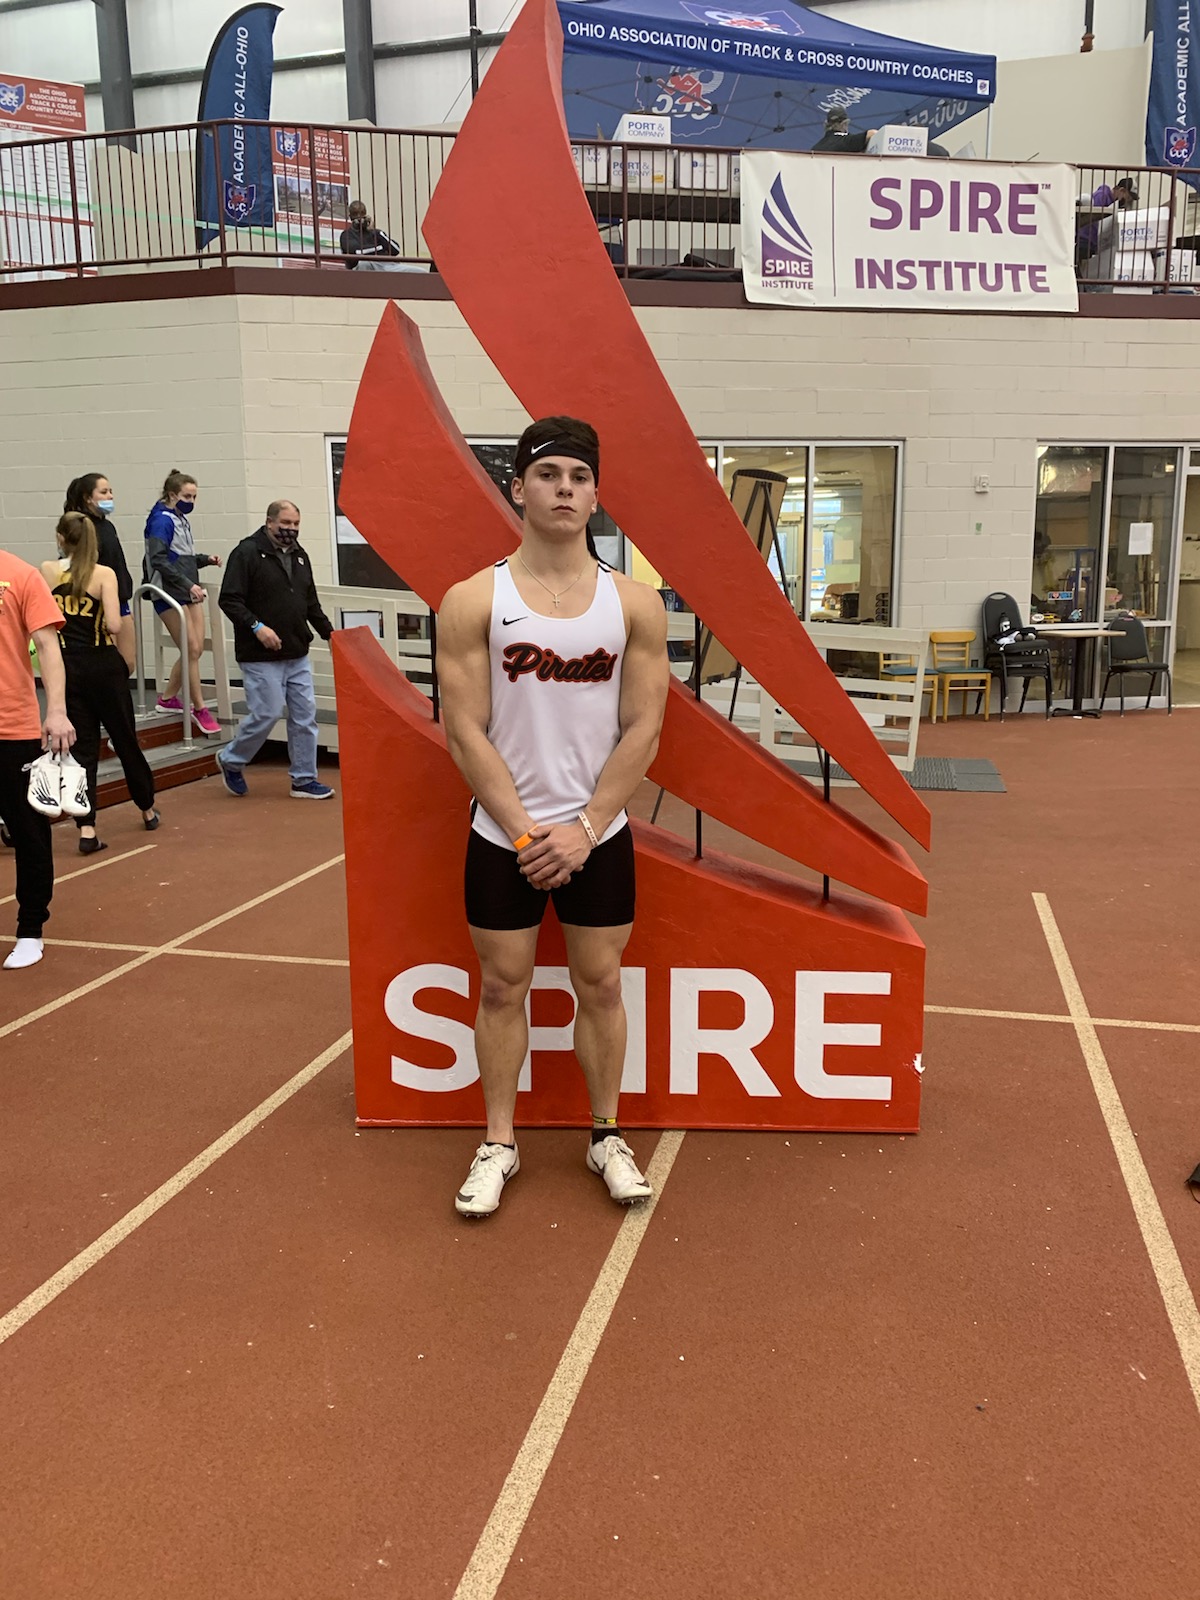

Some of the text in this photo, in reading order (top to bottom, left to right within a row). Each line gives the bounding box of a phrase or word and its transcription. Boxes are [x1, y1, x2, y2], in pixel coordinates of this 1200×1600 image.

[567, 20, 974, 84] OHIO ASSOCIATION OF TRACK & CROSS COUNTRY COACHES
[234, 26, 249, 100] ALL-OHIO
[1176, 37, 1190, 126] ACADEMIC
[29, 93, 68, 104] ASSOCIATION
[31, 99, 51, 107] TRACK
[57, 102, 76, 111] CROSS
[26, 105, 54, 114] COUNTRY
[55, 109, 82, 118] COACHES
[628, 121, 656, 130] PORT
[888, 137, 915, 146] PORT
[887, 145, 922, 153] COMPANY
[869, 176, 1039, 235] SPIRE
[765, 259, 810, 275] SPIRE
[854, 257, 1051, 294] INSTITUTE
[761, 280, 814, 290] INSTITUTE
[383, 962, 893, 1100] SPIRE
